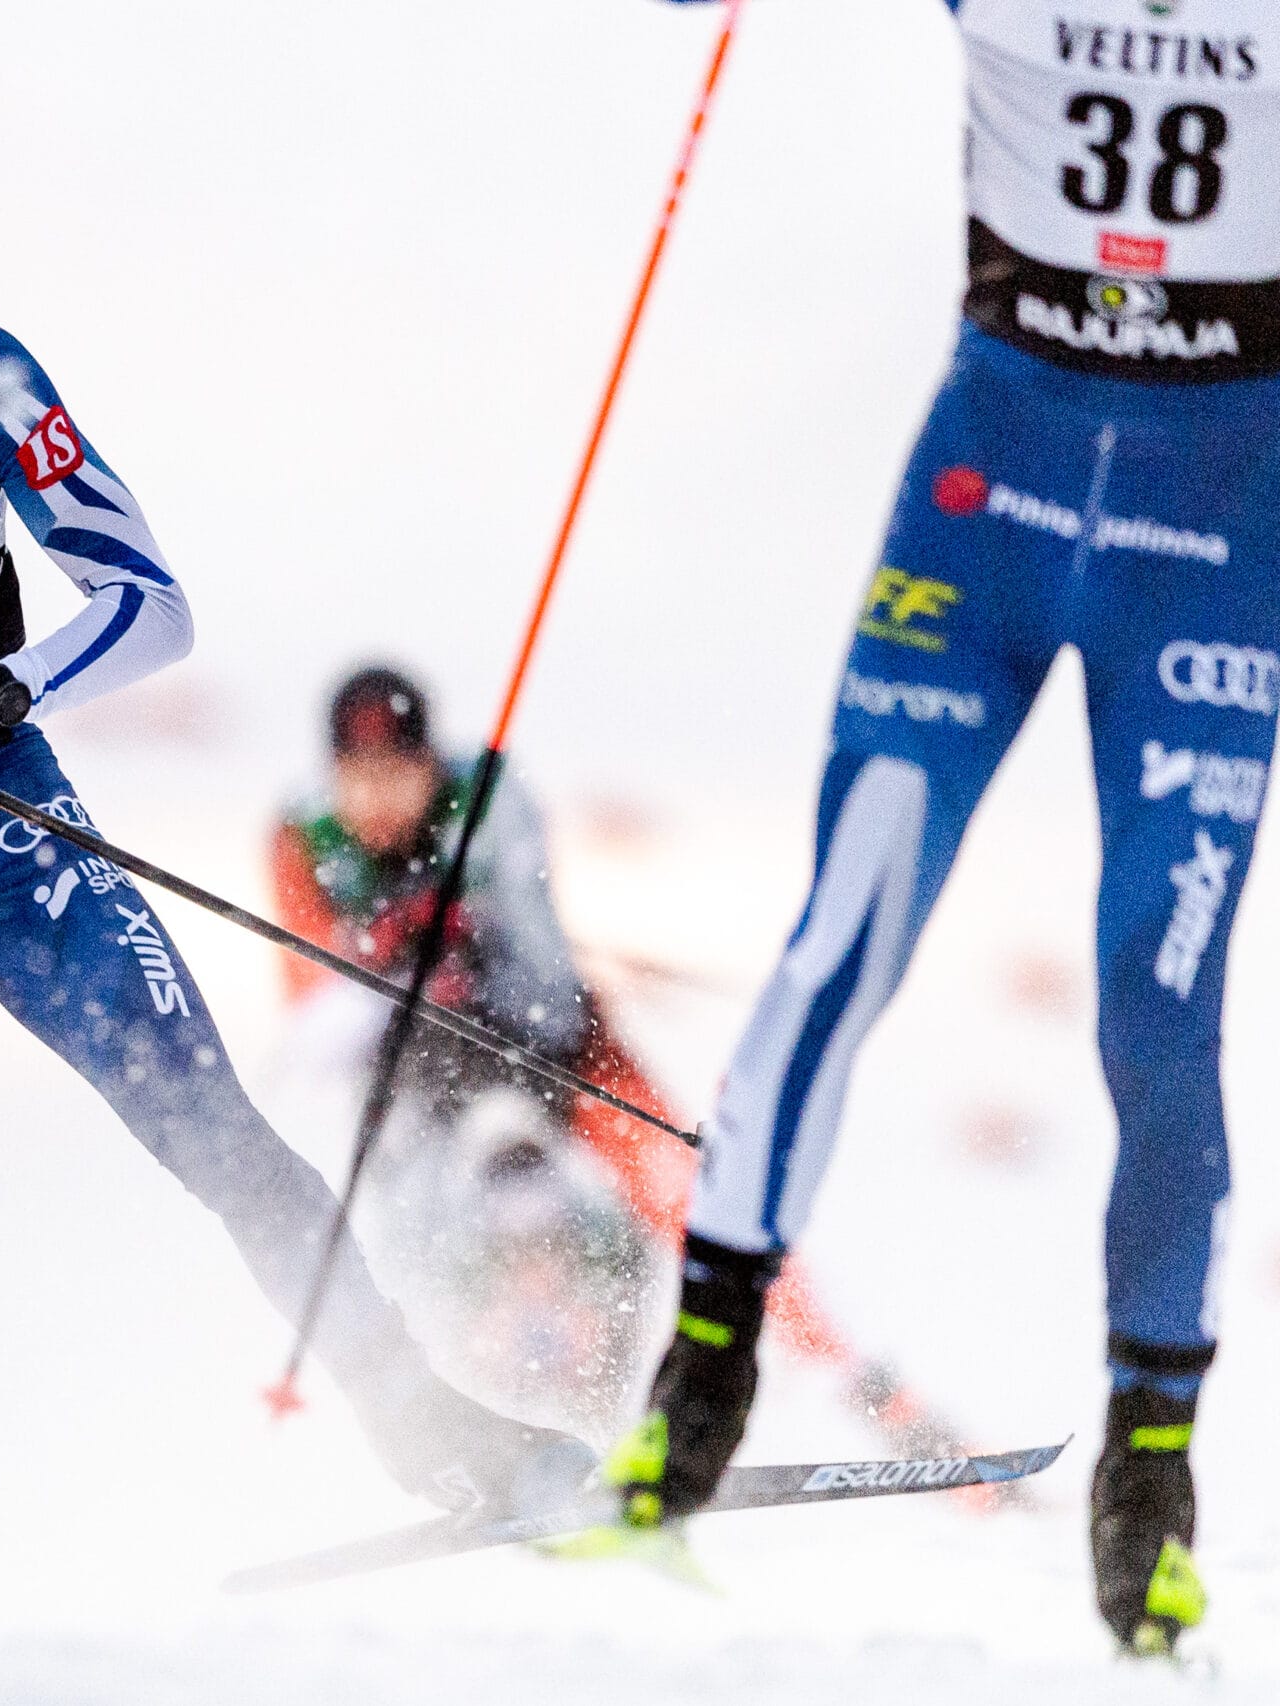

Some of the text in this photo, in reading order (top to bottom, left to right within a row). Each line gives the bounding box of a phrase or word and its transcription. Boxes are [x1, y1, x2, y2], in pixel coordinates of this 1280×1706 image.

[1055, 16, 1258, 80] VELTINS
[1060, 92, 1230, 227] 38
[27, 415, 77, 481] IS
